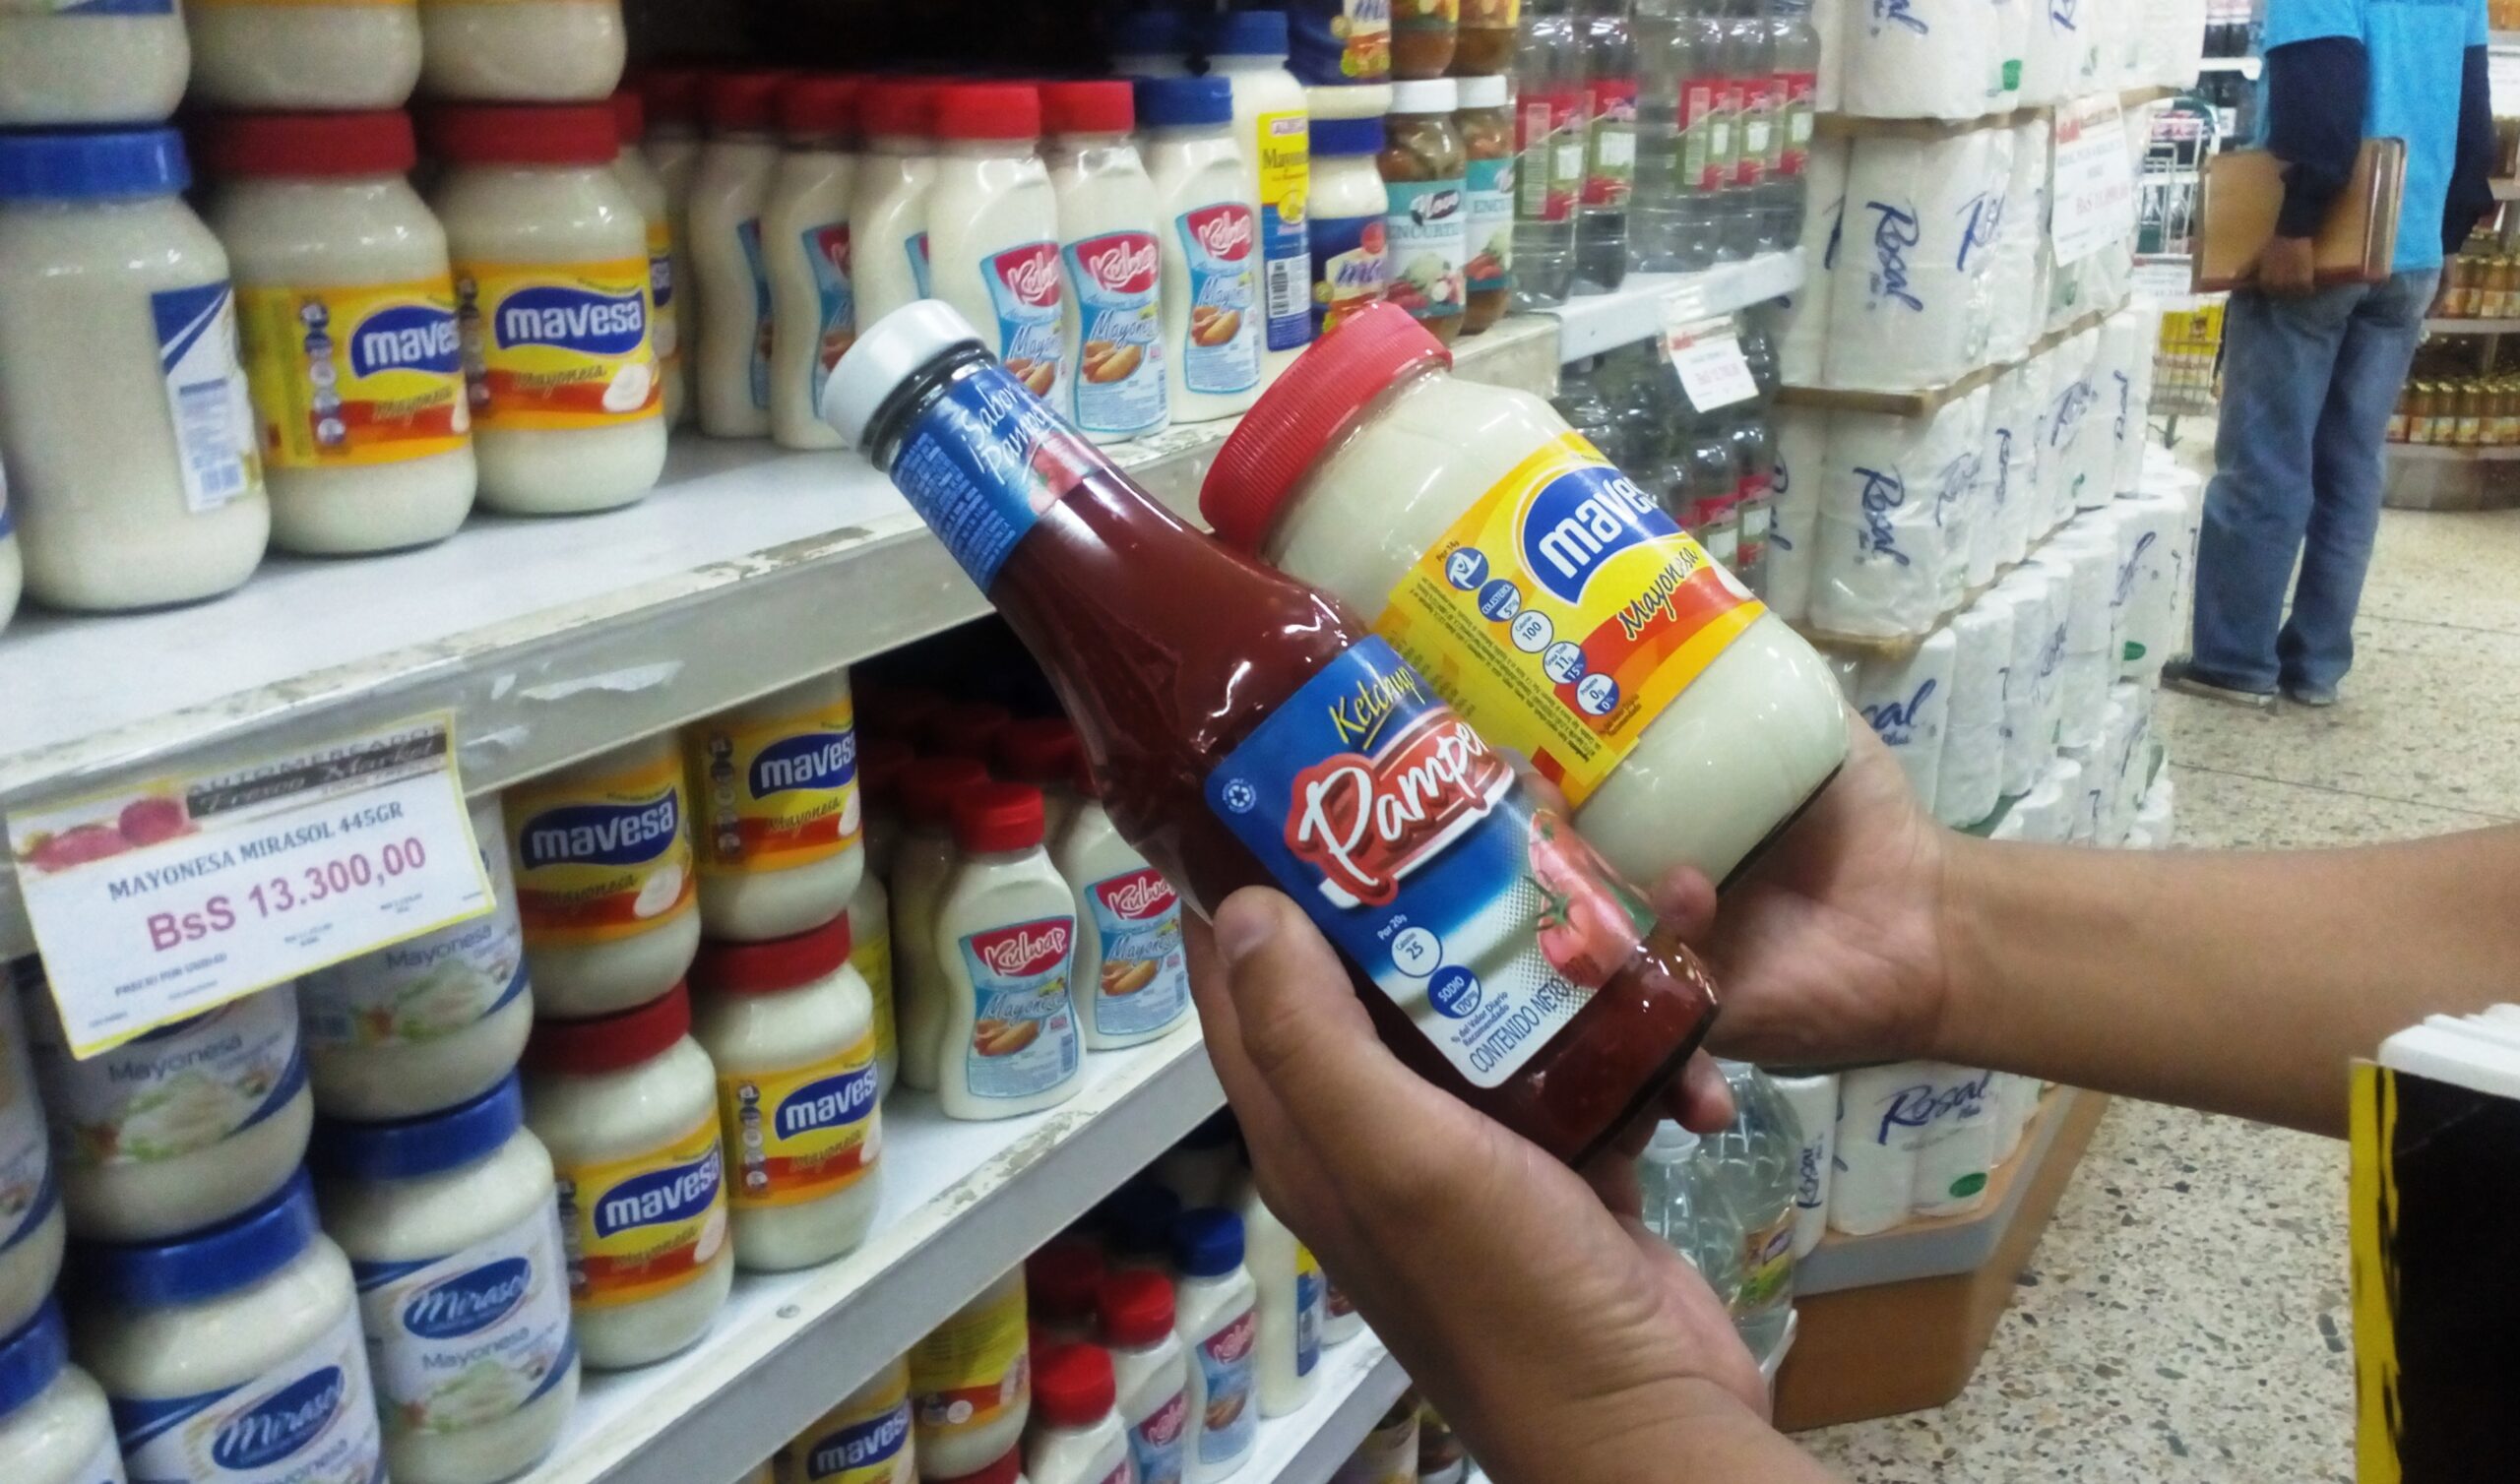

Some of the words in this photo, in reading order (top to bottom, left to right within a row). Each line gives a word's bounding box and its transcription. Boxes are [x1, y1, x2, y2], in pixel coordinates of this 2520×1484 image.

[362, 319, 461, 367] maves
[506, 300, 642, 340] mavesa
[1538, 475, 1658, 581] maves
[1616, 544, 1699, 640] Mayonesa
[1522, 621, 1542, 641] 100
[1329, 665, 1425, 744] Ketchup
[108, 849, 236, 901] MAYONESA
[238, 821, 336, 865] MIRASOL
[338, 800, 405, 835] 445GR
[532, 799, 675, 860] mavesa
[147, 895, 237, 953] BsS
[247, 835, 427, 918] 13.300,00
[1405, 941, 1424, 960] 25
[1437, 975, 1466, 1002] SODIO
[1470, 1007, 1540, 1072] CONTENIDO
[1530, 976, 1572, 1017] NETO
